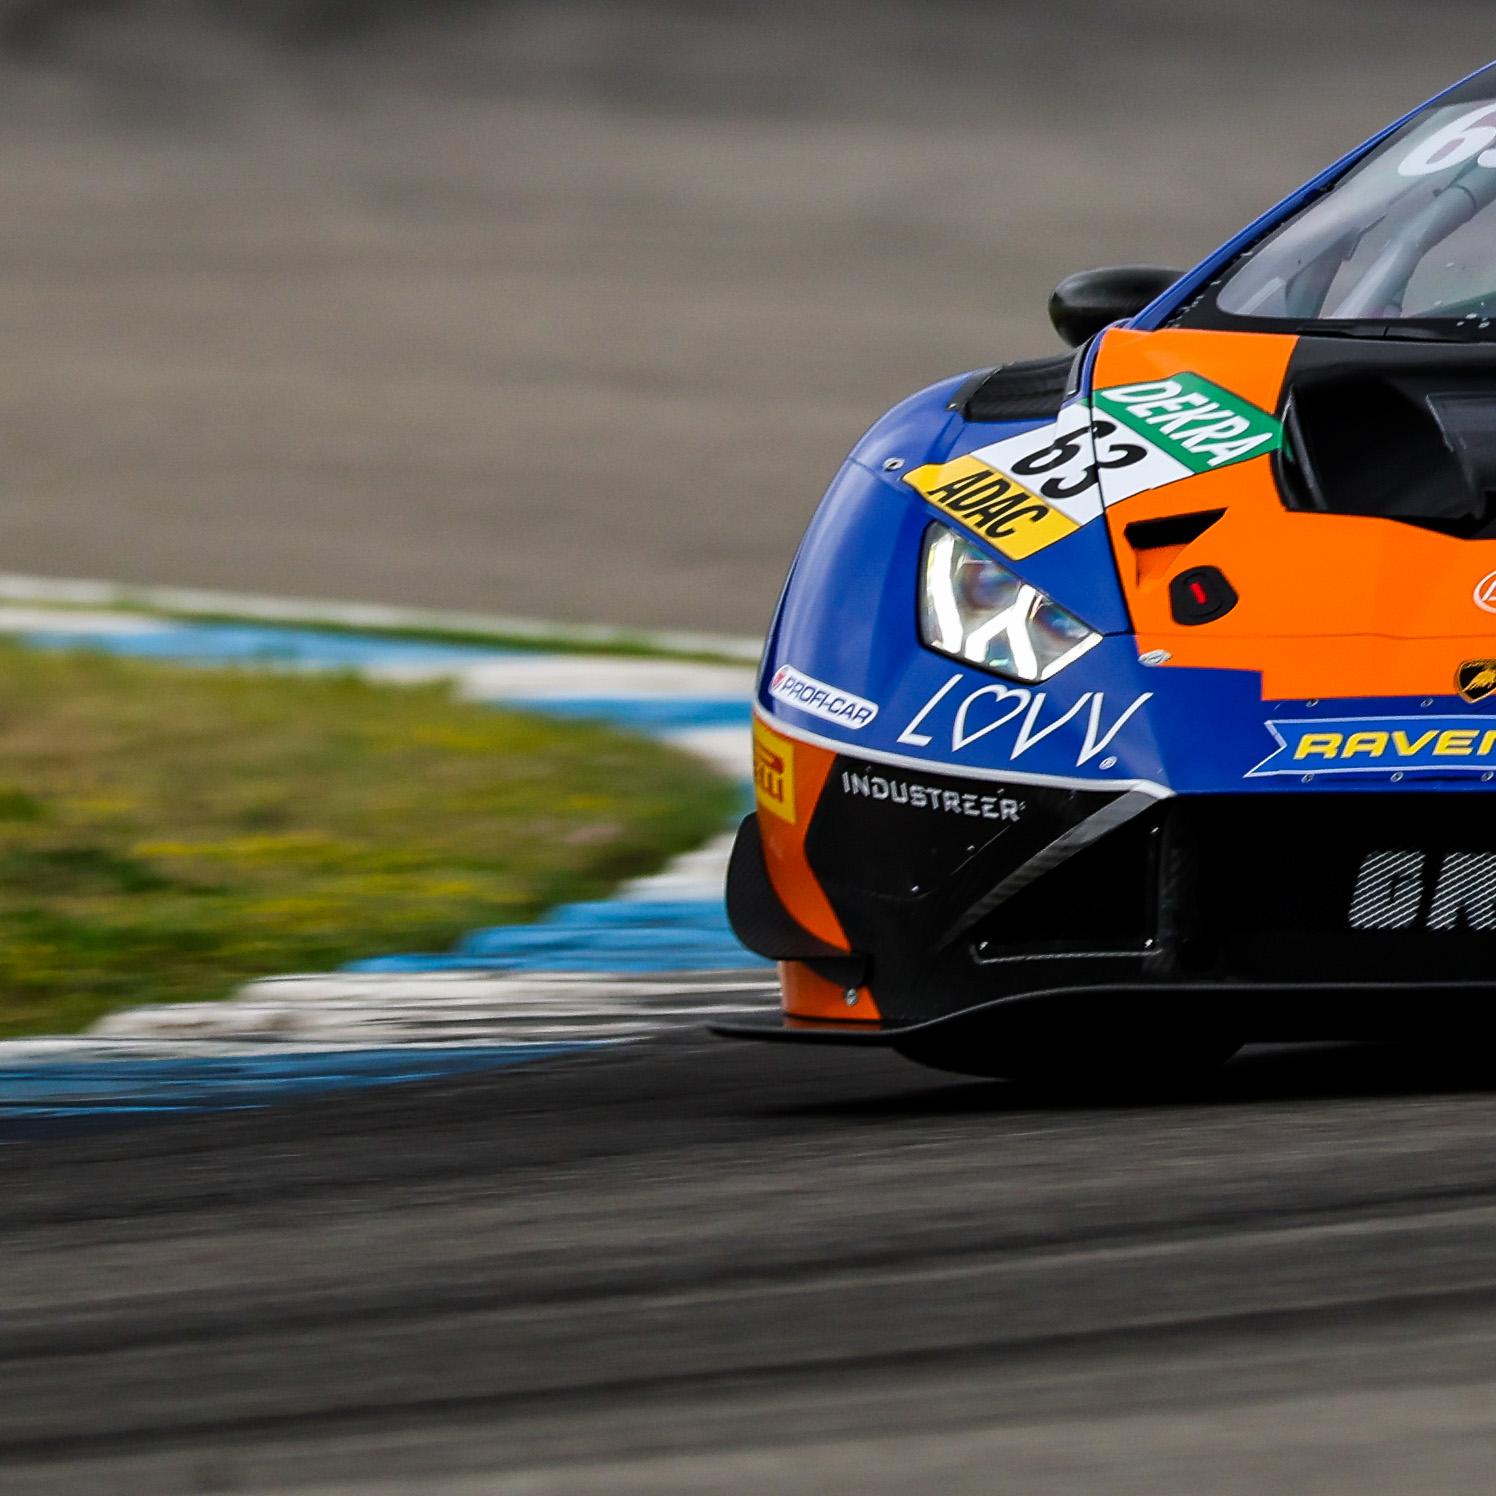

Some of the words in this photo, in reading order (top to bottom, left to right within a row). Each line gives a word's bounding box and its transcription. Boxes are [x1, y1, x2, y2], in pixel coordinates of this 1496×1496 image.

[1101, 377, 1273, 467] DEKRA
[1011, 419, 1148, 500] 63
[925, 468, 1047, 540] ADAC
[781, 676, 874, 725] PROFI-CAR
[841, 766, 1020, 821] INDUSTREER
